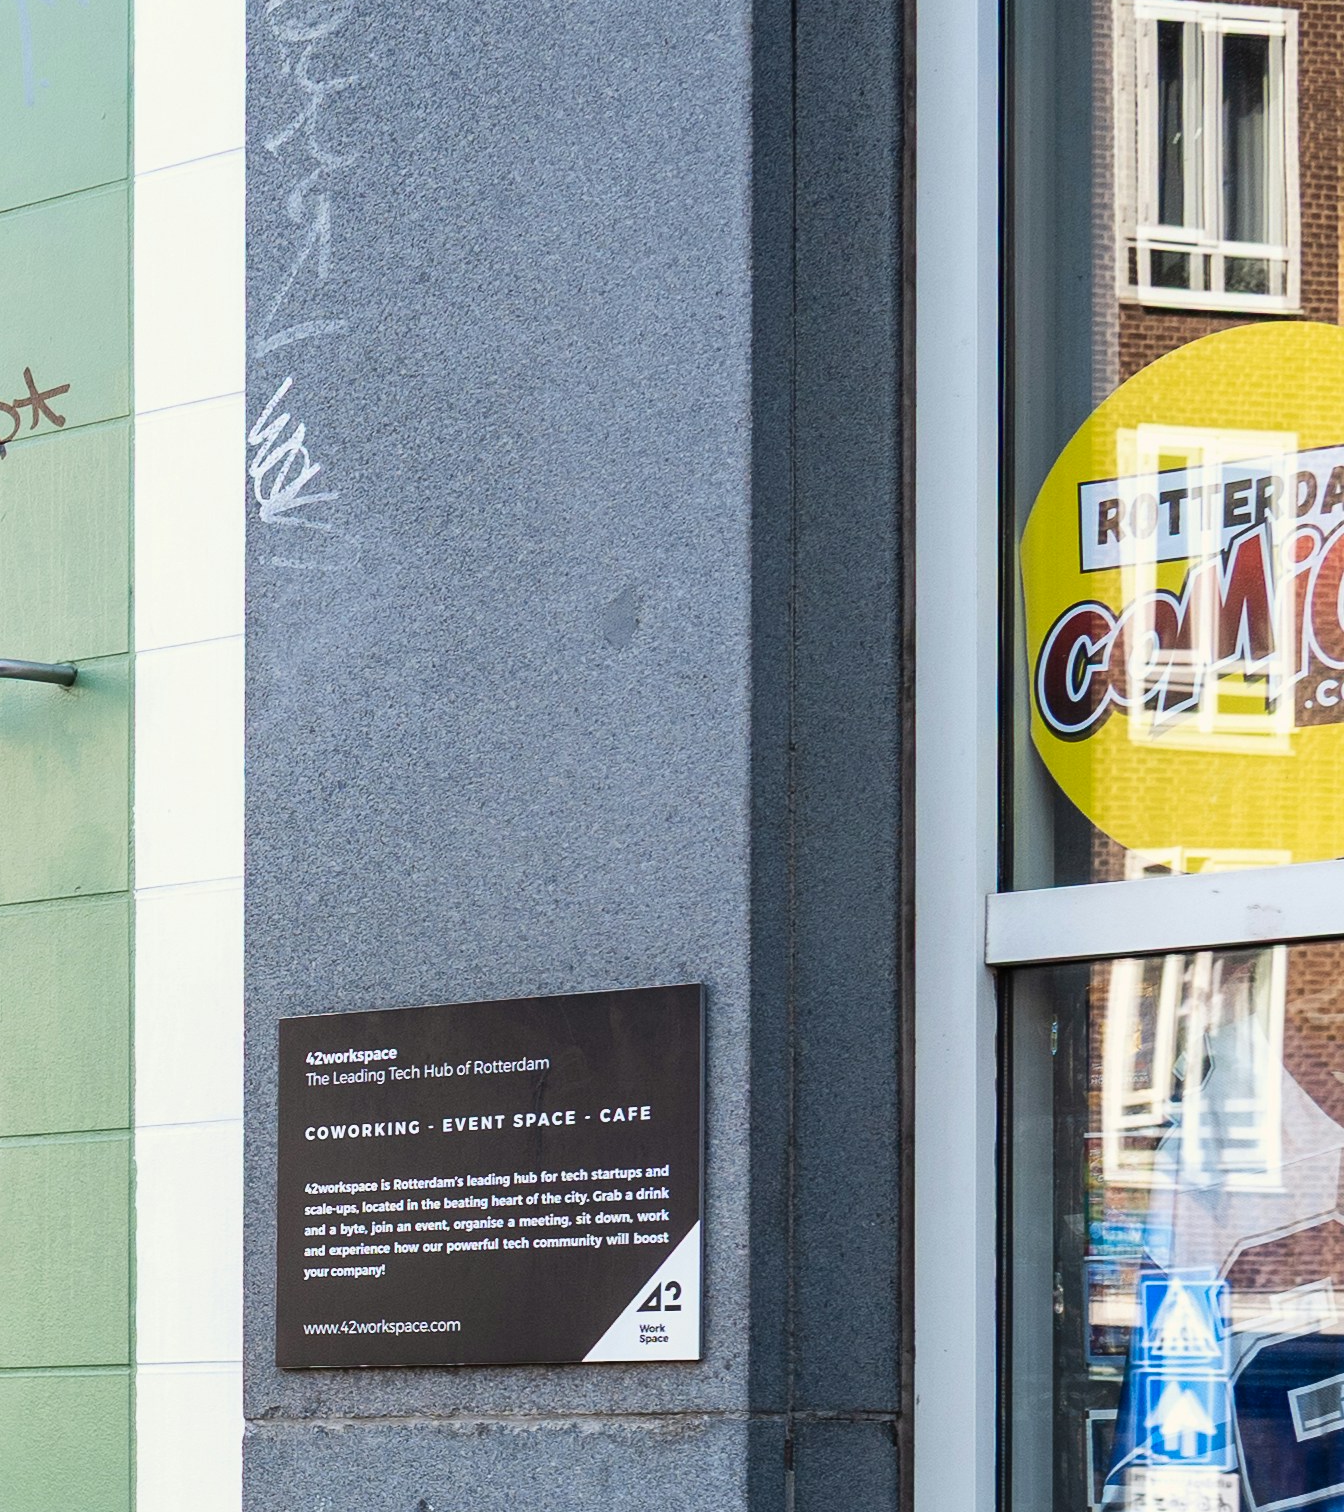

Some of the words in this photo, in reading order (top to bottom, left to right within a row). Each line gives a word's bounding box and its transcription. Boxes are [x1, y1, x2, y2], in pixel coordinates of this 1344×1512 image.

[306, 1048, 397, 1065] 42workspace
[306, 1072, 329, 1086] The
[333, 1068, 385, 1085] Leading
[390, 1066, 420, 1081] Tech
[424, 1064, 453, 1078] Hub
[456, 1061, 471, 1076] of
[474, 1056, 549, 1074] Rotterdam
[305, 1120, 420, 1141] COWORKING
[442, 1114, 506, 1133] EVENT
[513, 1110, 576, 1128] SPACE
[599, 1105, 652, 1123] CAFE
[304, 1181, 378, 1195] 42workspace
[381, 1179, 391, 1191] is
[393, 1176, 464, 1190] Rotterdam's
[466, 1173, 511, 1187] leading
[513, 1172, 538, 1184] hub
[540, 1170, 558, 1183] for
[561, 1169, 588, 1182] tech
[590, 1167, 643, 1182] startups
[645, 1164, 670, 1178] and
[304, 1203, 360, 1216] scale-ups,
[362, 1199, 404, 1213] located
[407, 1198, 419, 1211] in
[421, 1198, 441, 1210] the
[443, 1195, 489, 1210] beating
[491, 1194, 523, 1207] heart
[526, 1192, 539, 1205] of
[541, 1192, 562, 1204] the
[564, 1190, 590, 1205] city.
[592, 1189, 622, 1202] Grab
[625, 1191, 633, 1201] a
[635, 1187, 670, 1200] drink
[304, 1224, 326, 1236] and
[329, 1226, 337, 1235] a
[340, 1223, 368, 1236] byte,
[370, 1221, 393, 1236] join
[397, 1222, 412, 1232] an
[415, 1219, 450, 1232] event,
[453, 1216, 504, 1231] organise
[507, 1218, 515, 1228] a
[519, 1214, 572, 1228] meeting,
[576, 1212, 591, 1225] sit
[595, 1211, 633, 1224] down,
[637, 1209, 670, 1222] work
[304, 1244, 326, 1257] and
[329, 1243, 391, 1258] experience
[394, 1242, 419, 1254] how
[422, 1242, 443, 1253] our
[446, 1237, 499, 1254] powerful
[503, 1236, 529, 1249] tech
[533, 1234, 603, 1248] community
[606, 1233, 629, 1245] will
[633, 1232, 669, 1244] boost
[303, 1267, 329, 1280] your
[330, 1264, 386, 1278] company!
[303, 1318, 461, 1336] www.42workspace.com
[639, 1324, 666, 1334] Work
[639, 1334, 669, 1345] Space
